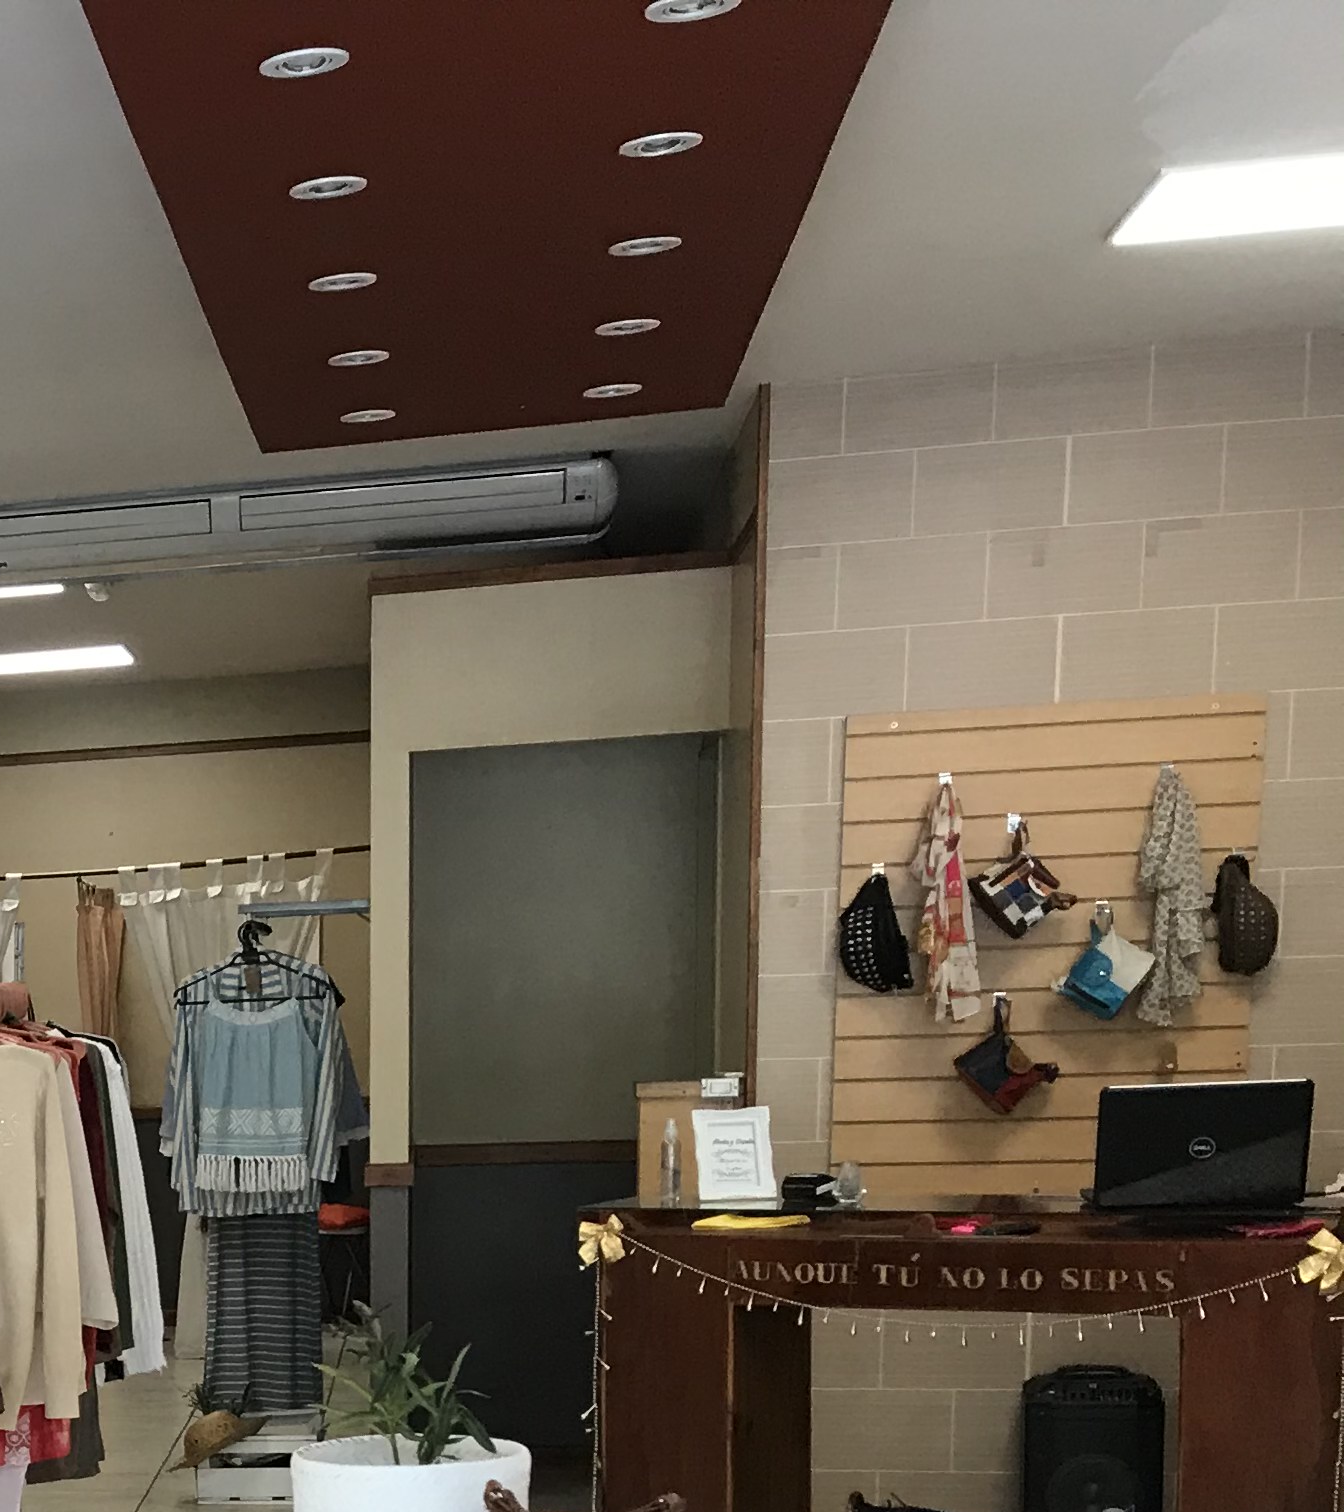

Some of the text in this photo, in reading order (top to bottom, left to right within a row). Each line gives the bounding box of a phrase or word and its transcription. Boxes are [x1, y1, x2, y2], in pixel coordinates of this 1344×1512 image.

[872, 1252, 921, 1288] TÚ
[937, 1265, 986, 1290] NO
[996, 1266, 1044, 1291] LO
[1061, 1267, 1175, 1293] SEPAS
